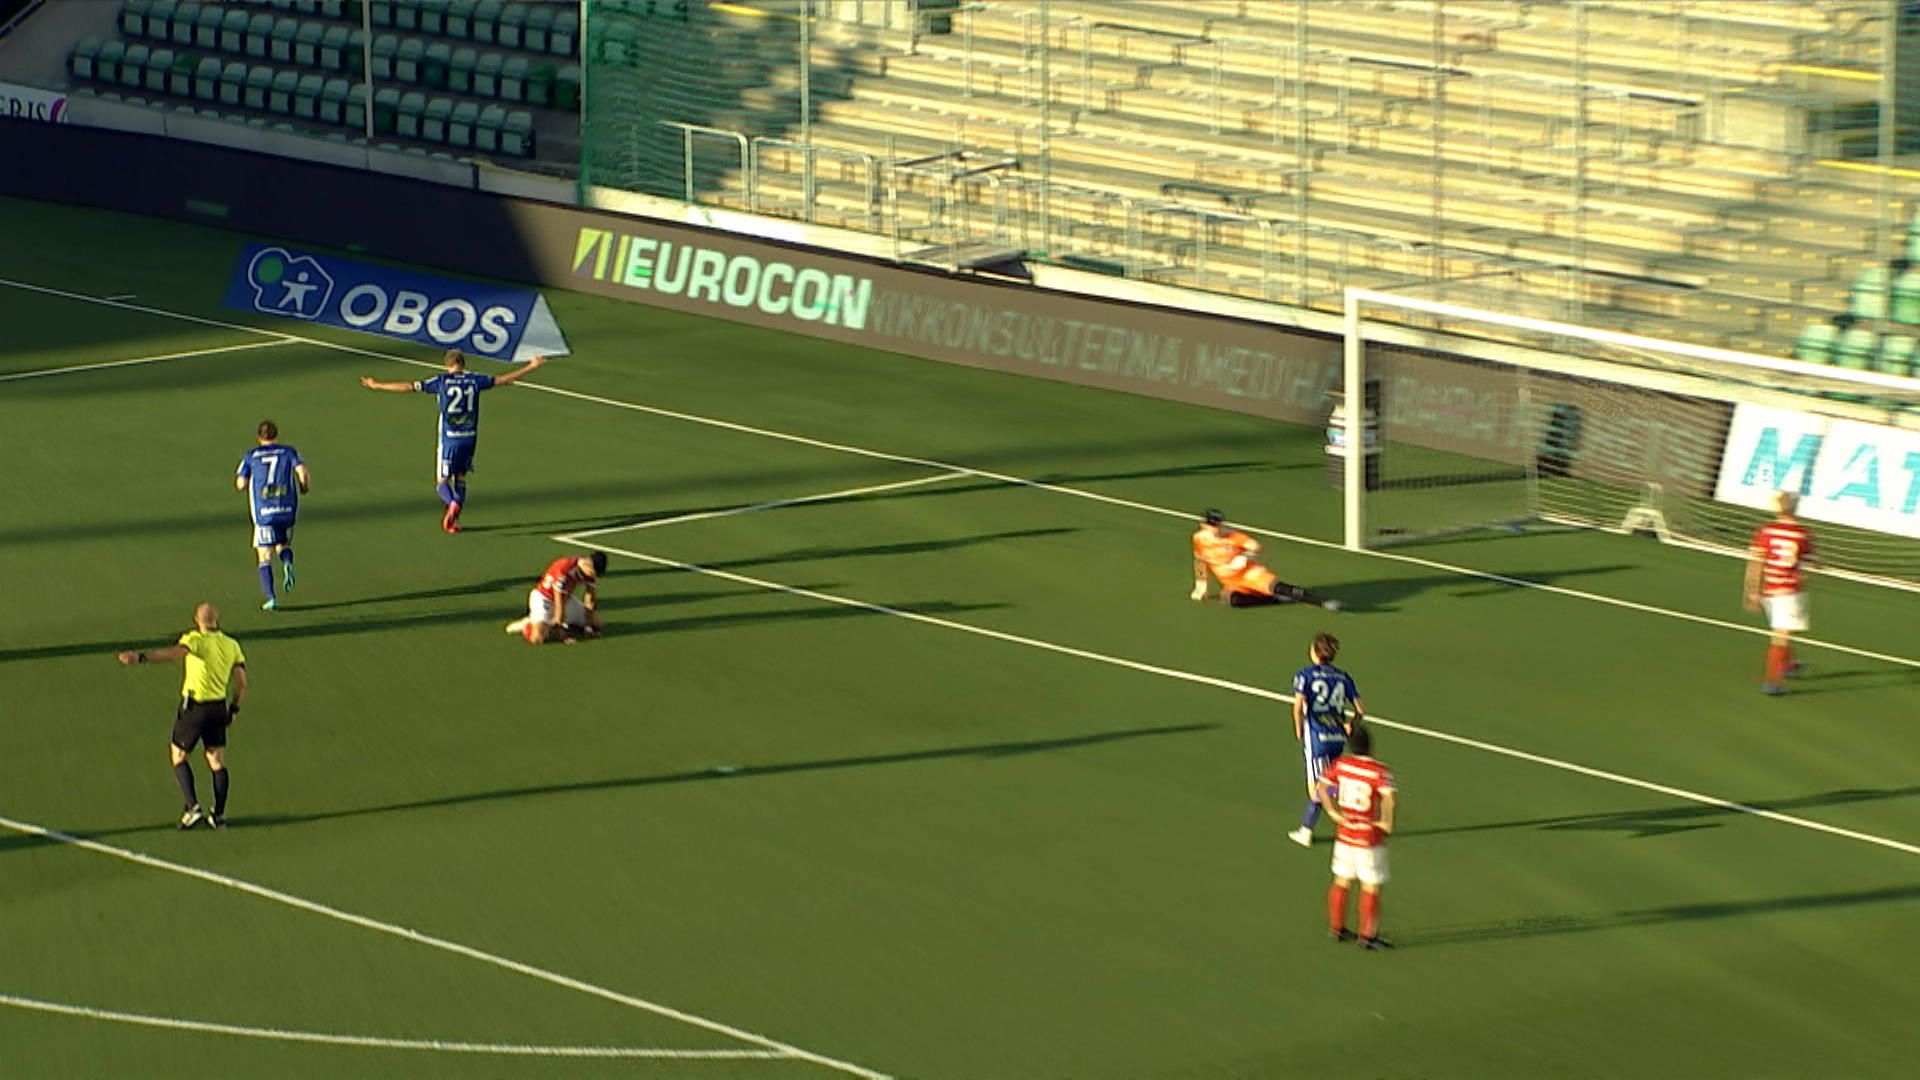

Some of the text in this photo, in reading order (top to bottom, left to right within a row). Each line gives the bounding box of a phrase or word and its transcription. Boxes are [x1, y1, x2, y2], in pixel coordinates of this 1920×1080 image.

[623, 236, 872, 329] EUROCON
[340, 284, 517, 353] OBOS
[446, 385, 475, 414] 21
[261, 455, 279, 485] 7
[1767, 537, 1799, 568] 3
[1311, 680, 1346, 713] 24
